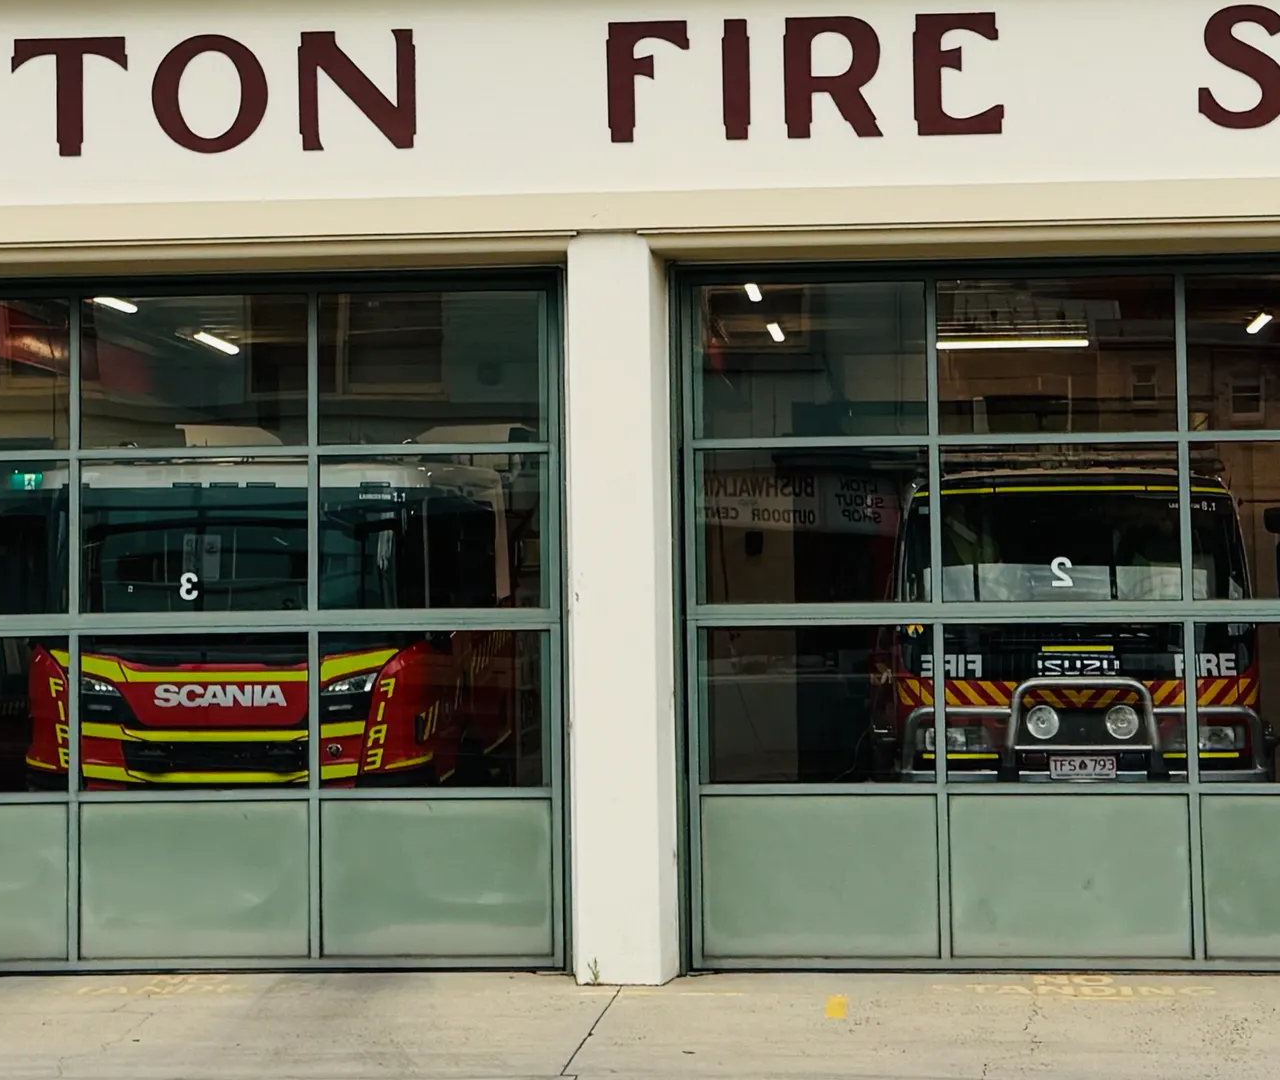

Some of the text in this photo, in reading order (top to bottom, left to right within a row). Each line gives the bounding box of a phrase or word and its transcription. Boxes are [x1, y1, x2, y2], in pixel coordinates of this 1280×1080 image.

[605, 11, 1005, 144] FIRE
[392, 492, 406, 502] 1.1
[1037, 659, 1120, 676] ISUZU
[153, 684, 288, 708] SCANIA
[49, 677, 70, 768] FIRE
[1051, 758, 1115, 772] TFS 793
[1032, 974, 1114, 986] NO
